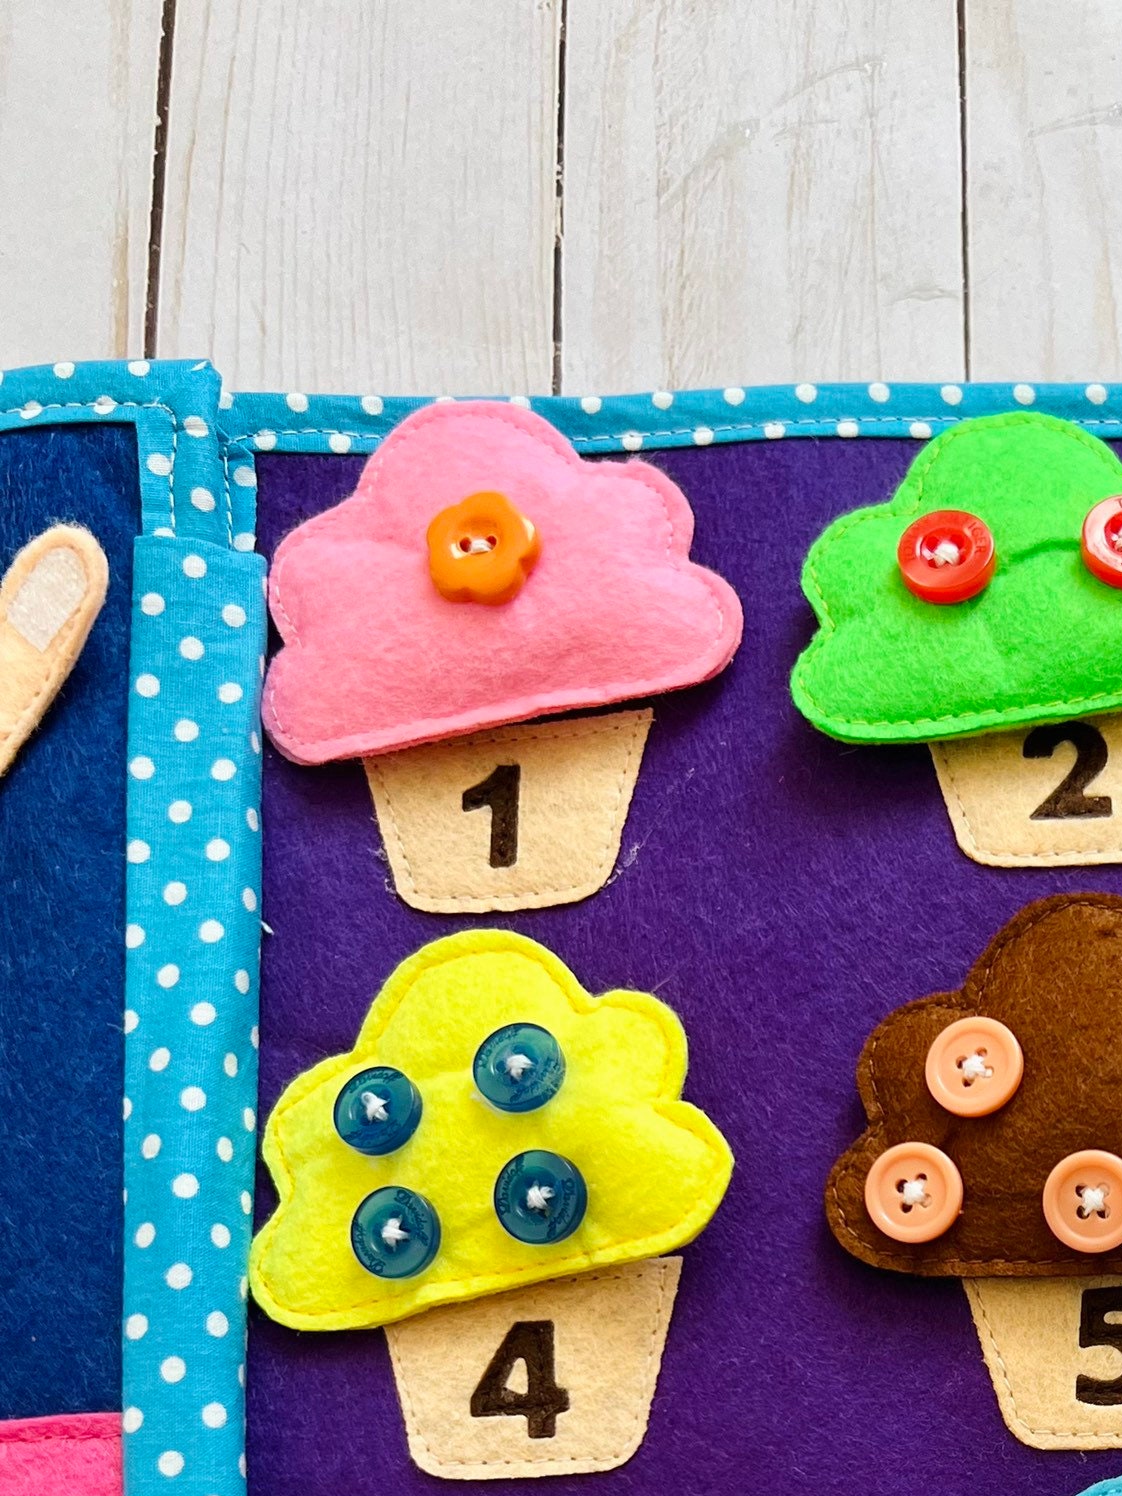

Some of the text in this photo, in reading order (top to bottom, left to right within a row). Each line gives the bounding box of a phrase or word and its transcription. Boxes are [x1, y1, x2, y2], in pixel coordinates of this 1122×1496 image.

[460, 764, 521, 869] 1
[1022, 721, 1113, 820] 2
[469, 1319, 570, 1440] 4
